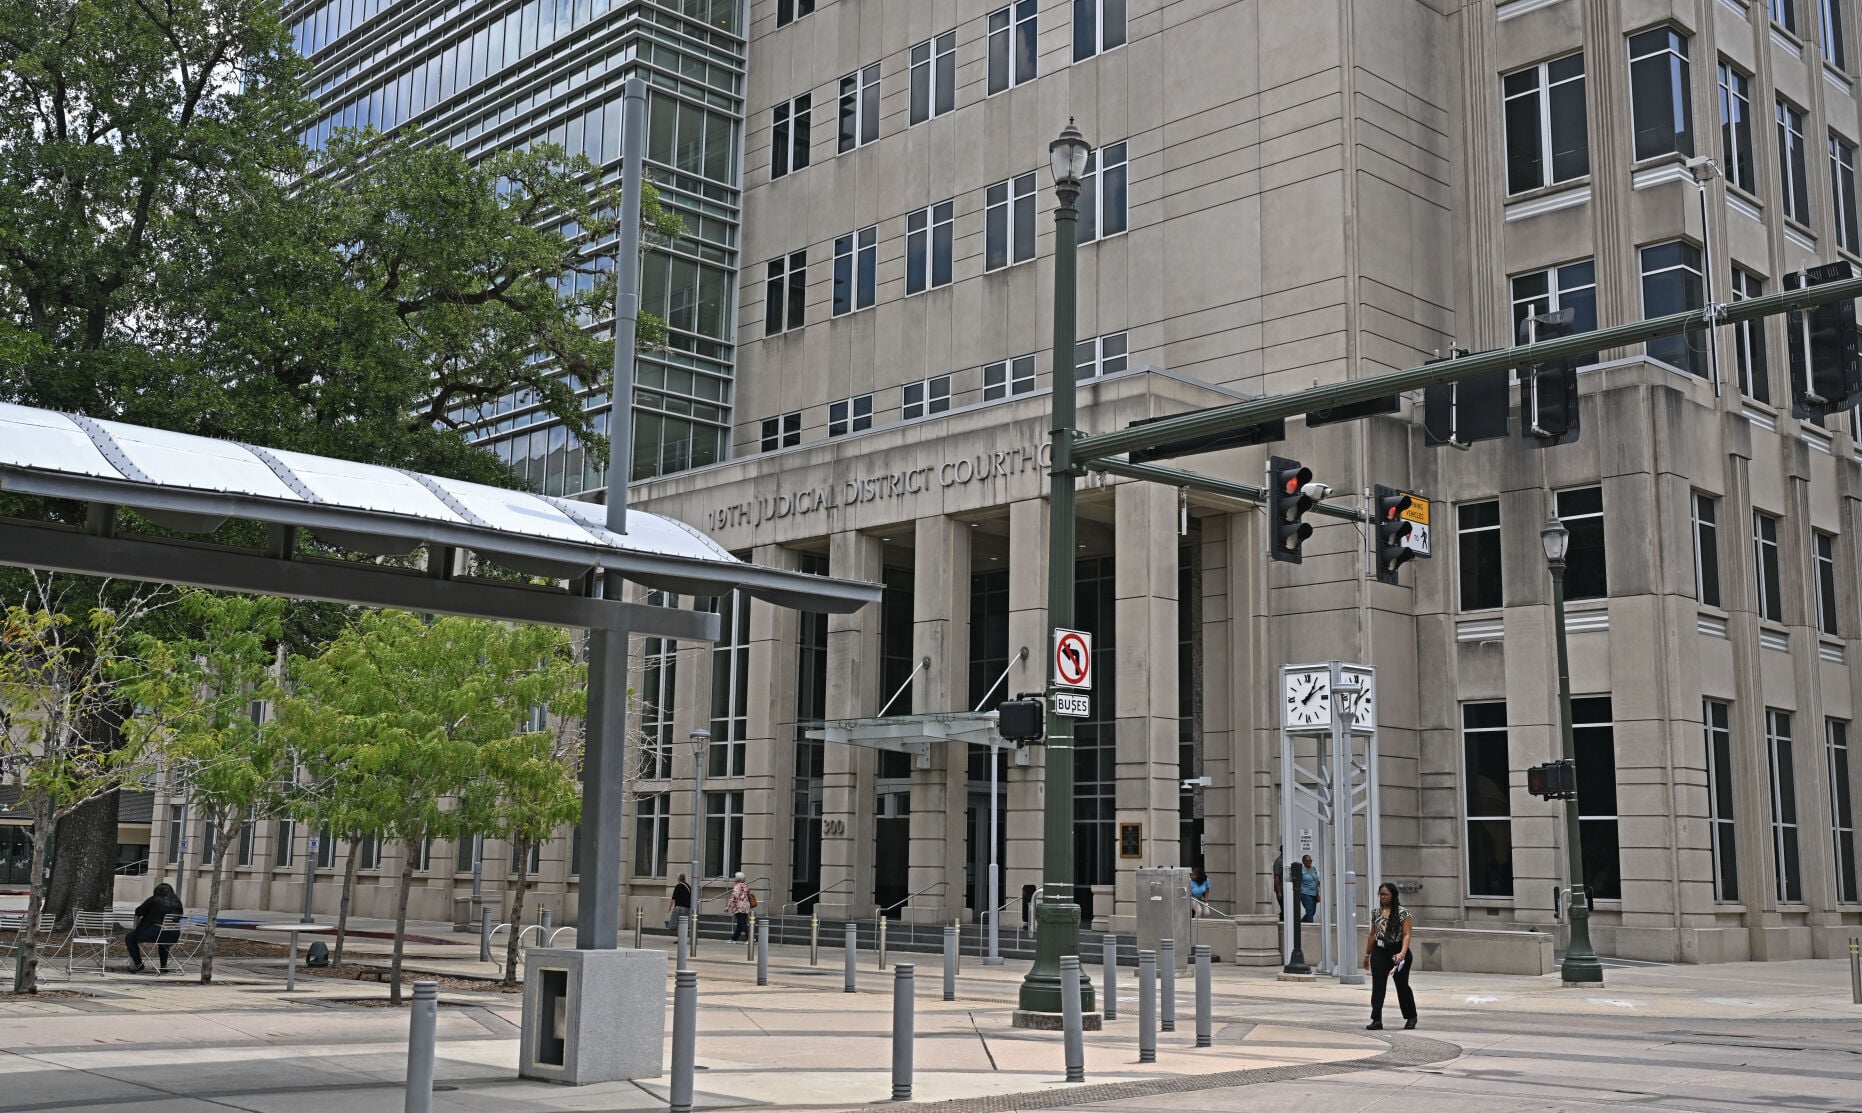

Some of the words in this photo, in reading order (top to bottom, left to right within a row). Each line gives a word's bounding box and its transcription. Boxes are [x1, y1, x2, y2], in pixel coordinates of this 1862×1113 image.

[708, 502, 751, 531] 19TH
[755, 485, 838, 528] JUDICIAL
[844, 465, 934, 506] DISTRICT
[939, 442, 1052, 487] COURTHO
[1406, 510, 1424, 520] VEHICLES
[1058, 698, 1087, 712] BUSES
[823, 819, 845, 835] 300
